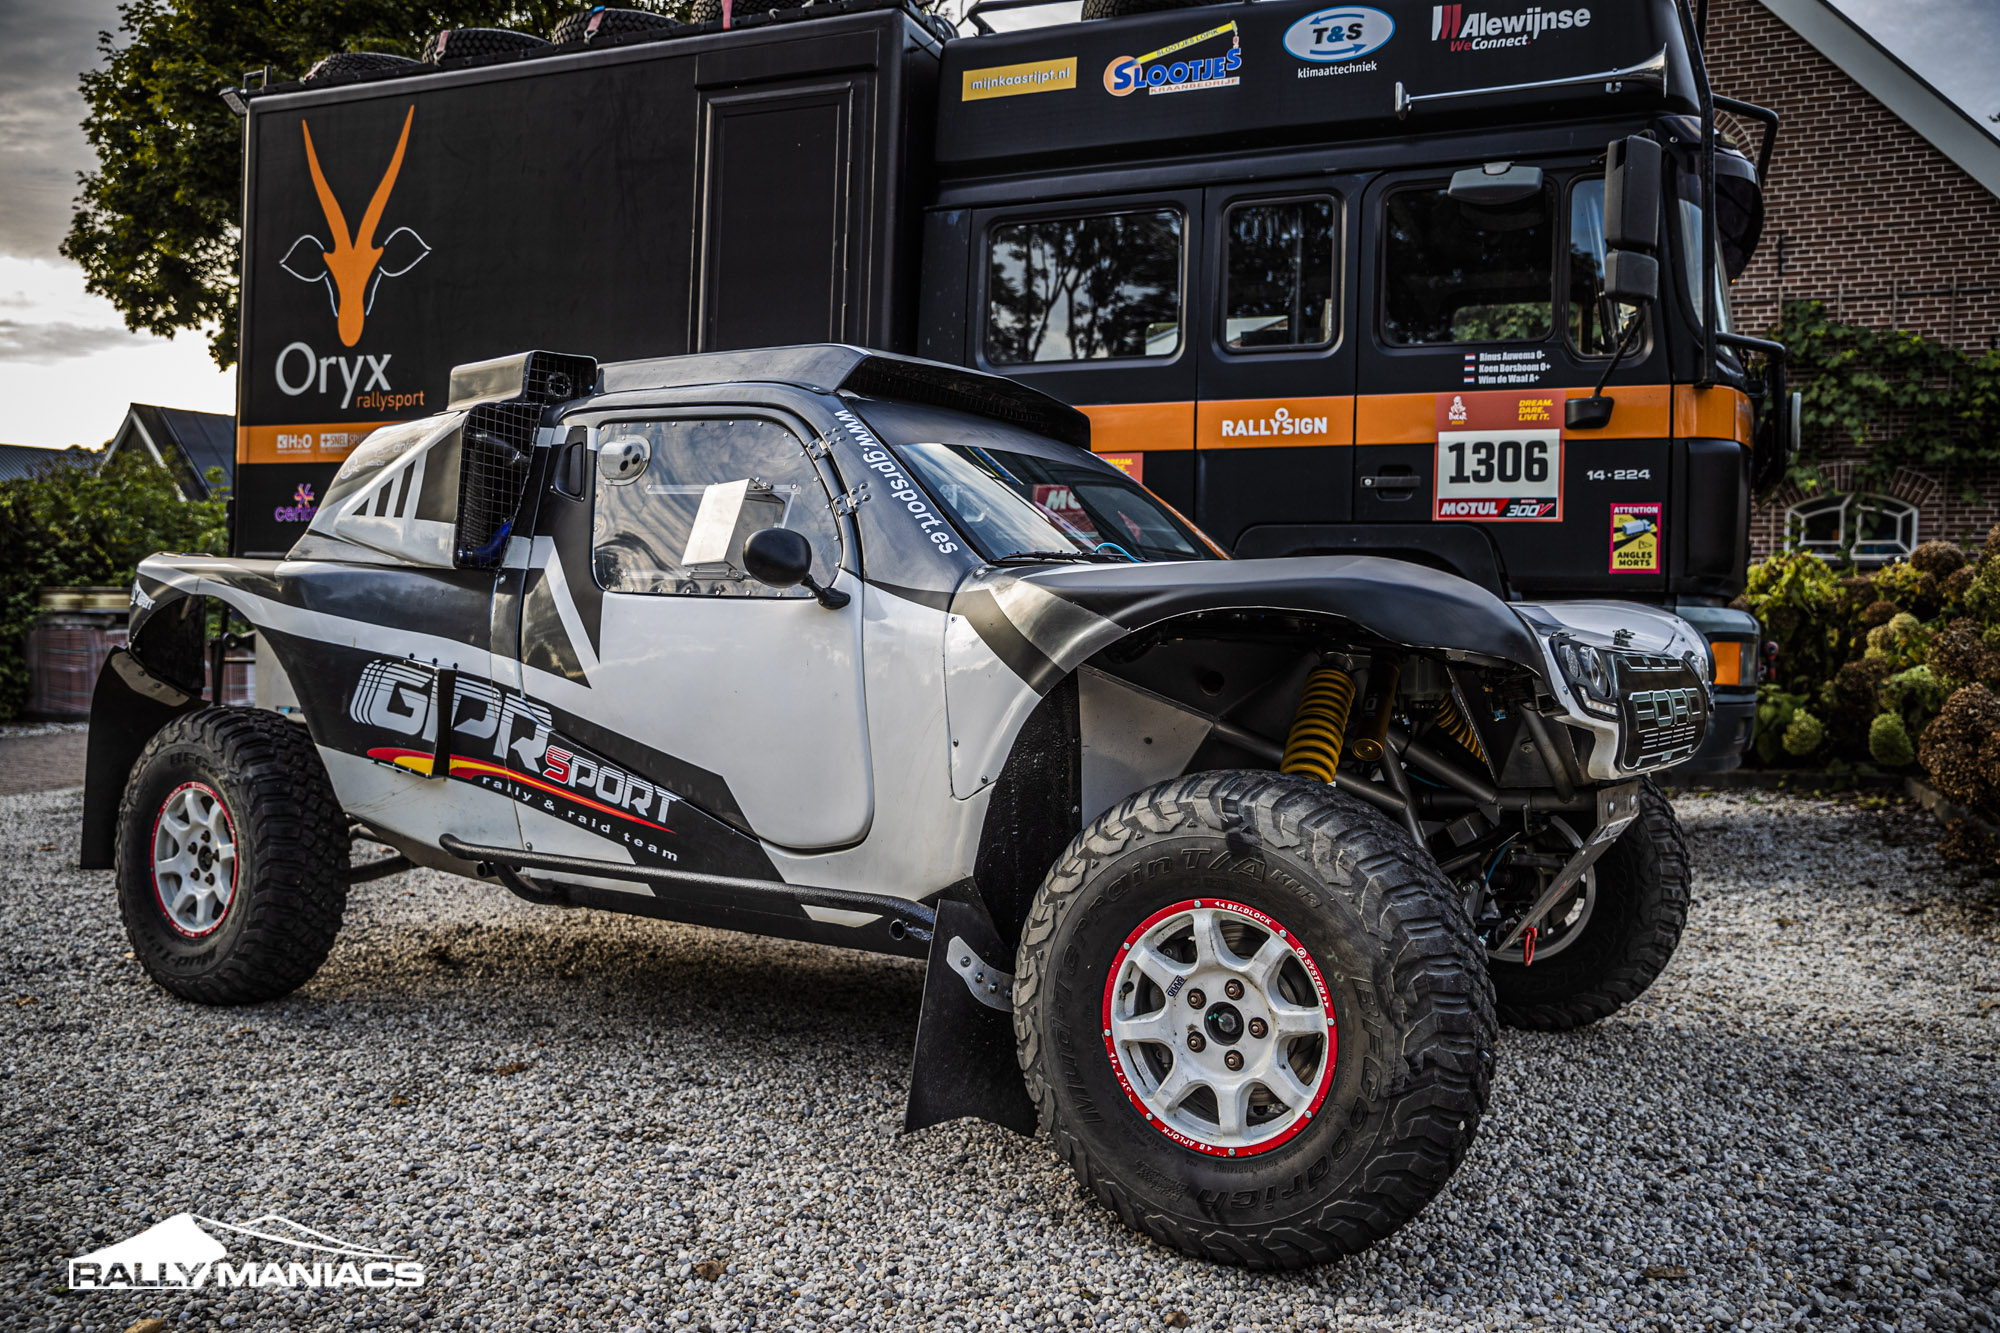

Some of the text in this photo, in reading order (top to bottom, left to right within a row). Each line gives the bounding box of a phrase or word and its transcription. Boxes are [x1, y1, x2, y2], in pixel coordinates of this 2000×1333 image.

[1460, 7, 1591, 40] Alewijnse
[1312, 23, 1363, 45] T&S
[1156, 37, 1195, 56] SLOOTJES
[1450, 35, 1532, 52] WeConnect.
[1113, 47, 1242, 90] SLOOTJES
[1297, 61, 1378, 79] klimaattechniek
[970, 66, 1071, 91] mijnkaasrijpt.nl
[1150, 78, 1237, 94] KRAANBEDRIJF
[1479, 352, 1501, 361] Rinus
[275, 341, 392, 410] Oryx
[1479, 364, 1499, 373] Koen
[1500, 363, 1539, 372] Borsboom
[1478, 374, 1540, 384] Wim de Waal A+
[356, 391, 425, 411] rallysport
[1518, 406, 1545, 414] DARE.
[1519, 399, 1553, 407] DREAM.
[1222, 415, 1328, 437] RALLYSIGN
[1518, 413, 1550, 421] LIVE IT.
[1448, 440, 1548, 484] 1306
[834, 409, 958, 554] www.gprsport.es
[1440, 502, 1555, 517] MOTUL 300V
[1613, 506, 1658, 514] ATTENTION
[1617, 551, 1652, 559] ANGLES
[1618, 559, 1651, 567] MORTS
[1628, 688, 1702, 733] FORD
[482, 776, 678, 862] rally & raid team
[1304, 957, 1327, 995] SYSTEM
